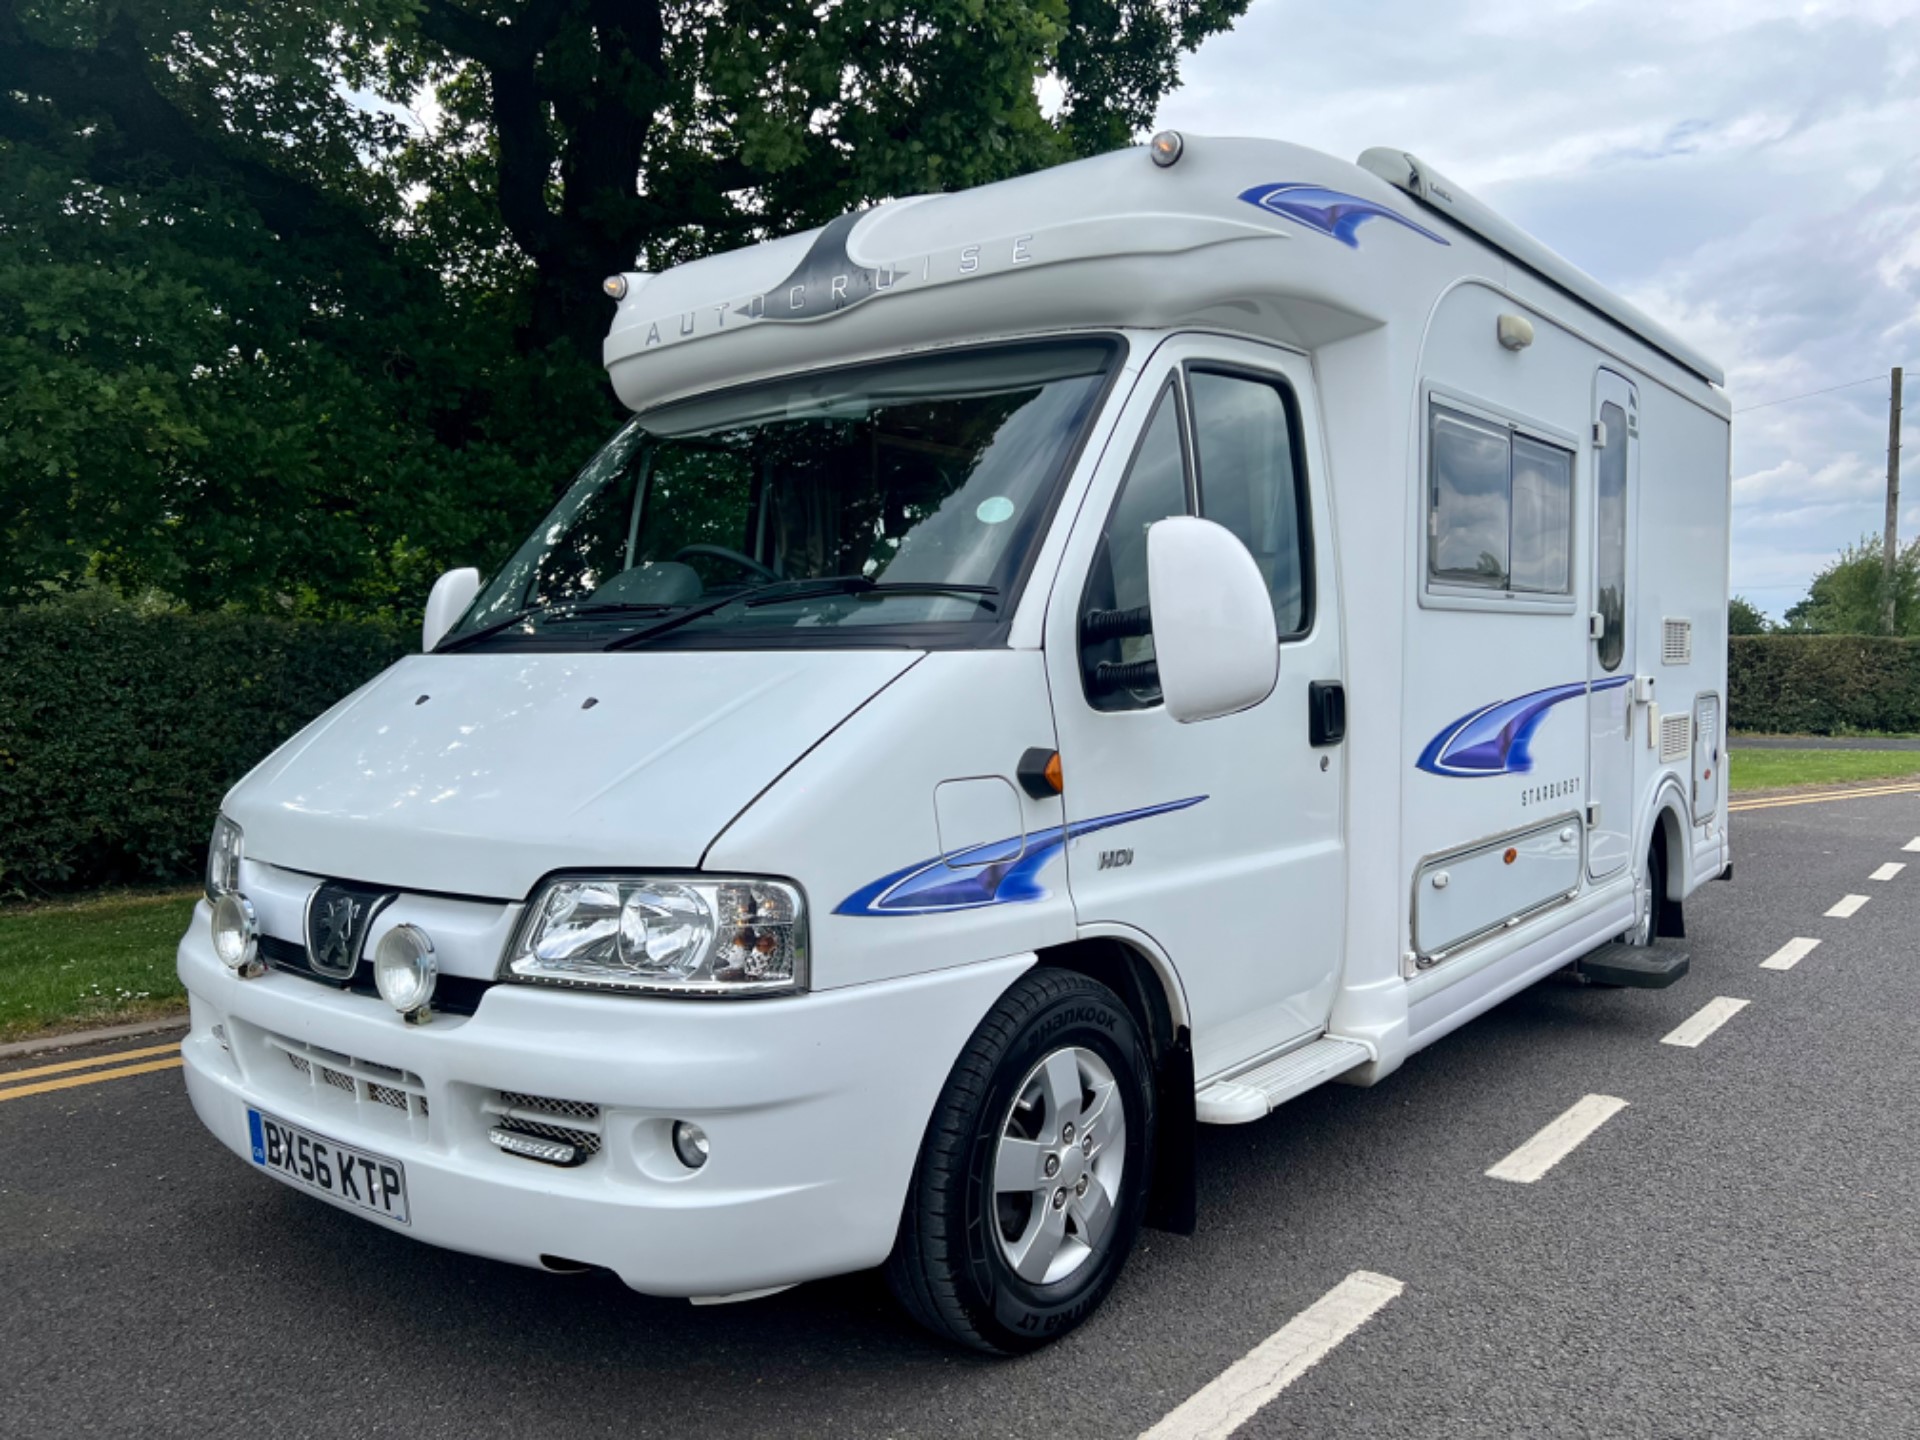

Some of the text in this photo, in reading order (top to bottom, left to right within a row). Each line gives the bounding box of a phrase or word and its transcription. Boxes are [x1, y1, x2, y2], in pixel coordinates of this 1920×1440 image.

[644, 234, 1034, 347] AUTOCRUISE
[1521, 776, 1580, 807] STARBURST
[264, 1119, 401, 1211] BX56 KTP
